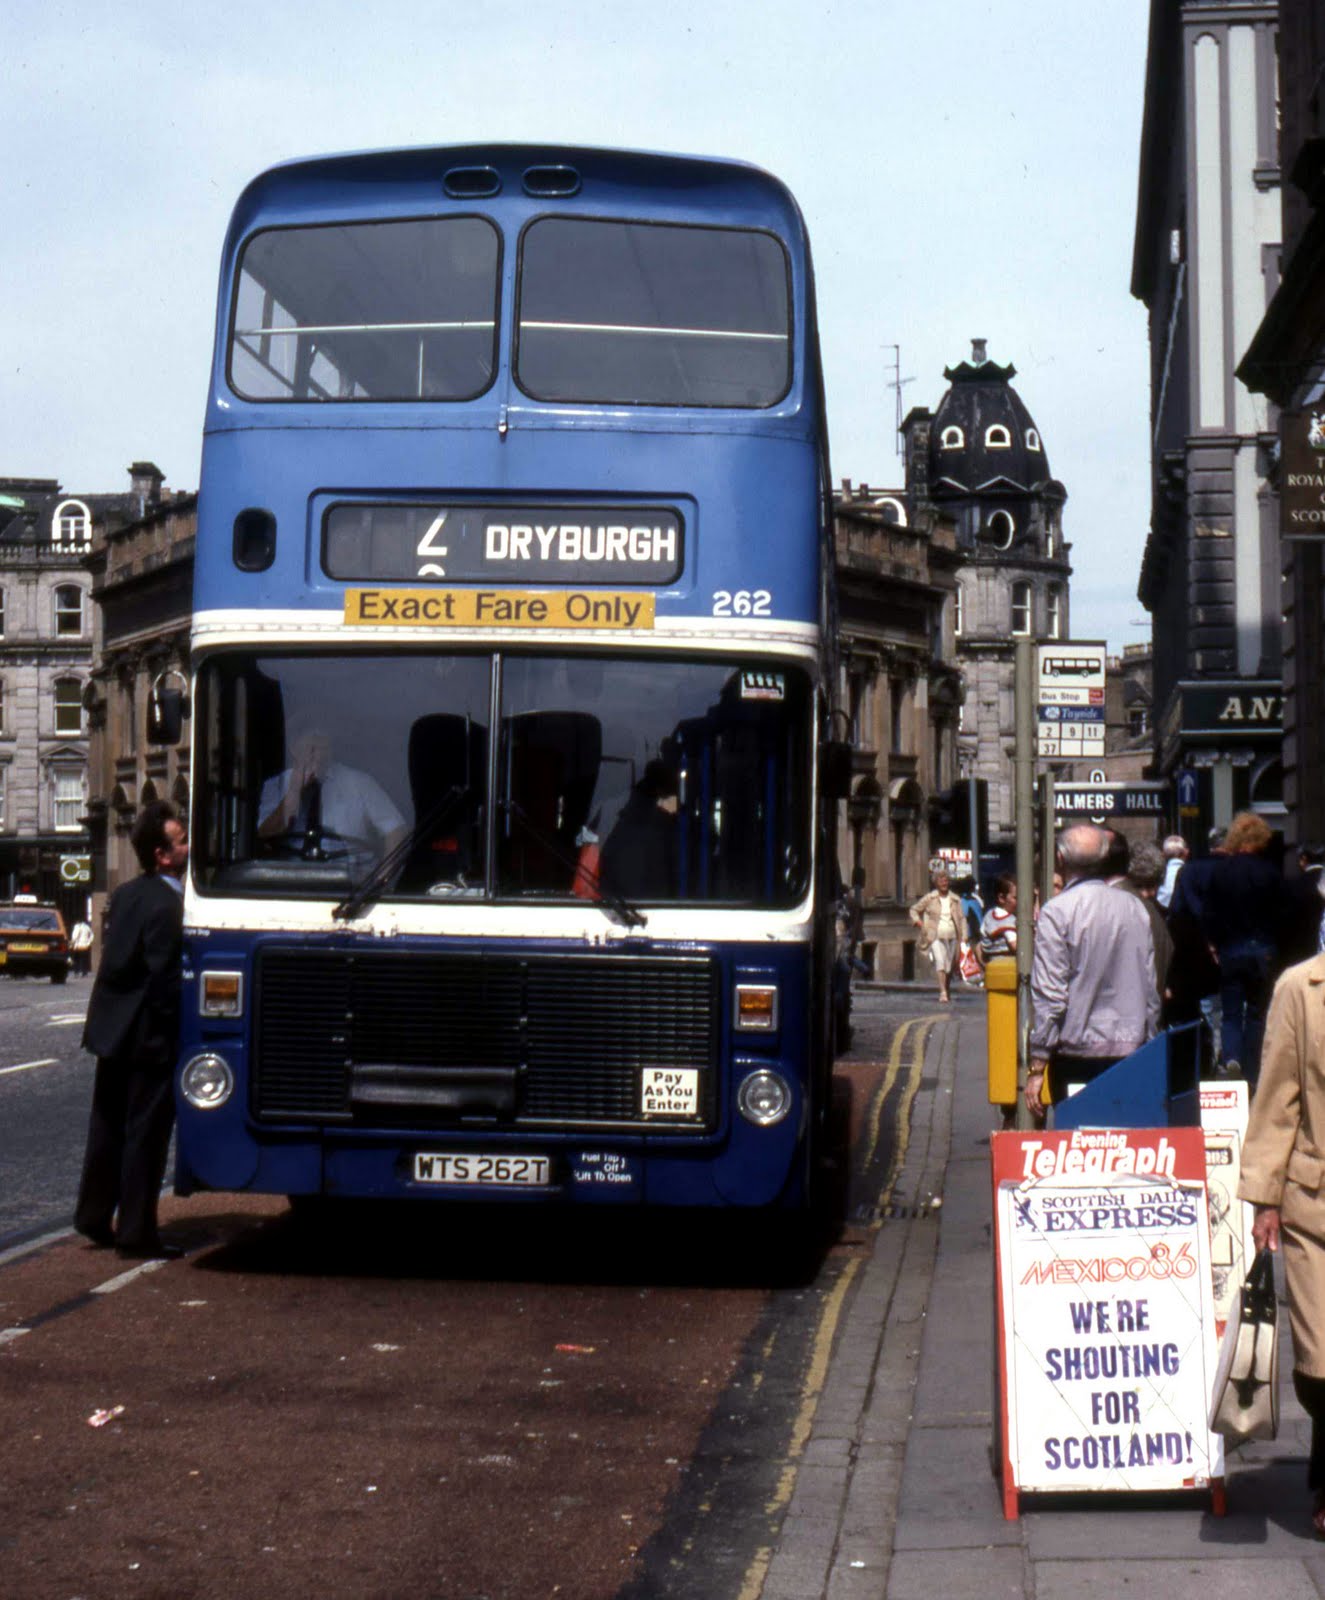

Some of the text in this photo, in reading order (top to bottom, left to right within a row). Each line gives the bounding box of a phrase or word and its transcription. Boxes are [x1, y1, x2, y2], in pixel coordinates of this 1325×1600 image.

[1287, 474, 1325, 487] ROYA
[485, 525, 676, 561] DRYBURGH
[358, 592, 642, 626] Exact Fare Only
[712, 590, 772, 617] 262
[1054, 794, 1162, 810] ALMERS HALL
[654, 1071, 682, 1085] Pay
[647, 1099, 690, 1110] Enter
[1071, 1131, 1127, 1149] Evening
[418, 1155, 548, 1182] WTS 262T
[1021, 1138, 1176, 1180] Telegraph
[607, 1172, 632, 1183] Open
[1042, 1189, 1192, 1210] SCOTTISH DAILY
[1043, 1204, 1198, 1233] EXPRESS
[1045, 1343, 1180, 1381] SHOUTING
[1091, 1391, 1141, 1426] FOR
[1044, 1431, 1194, 1470] SCOTLAND!
